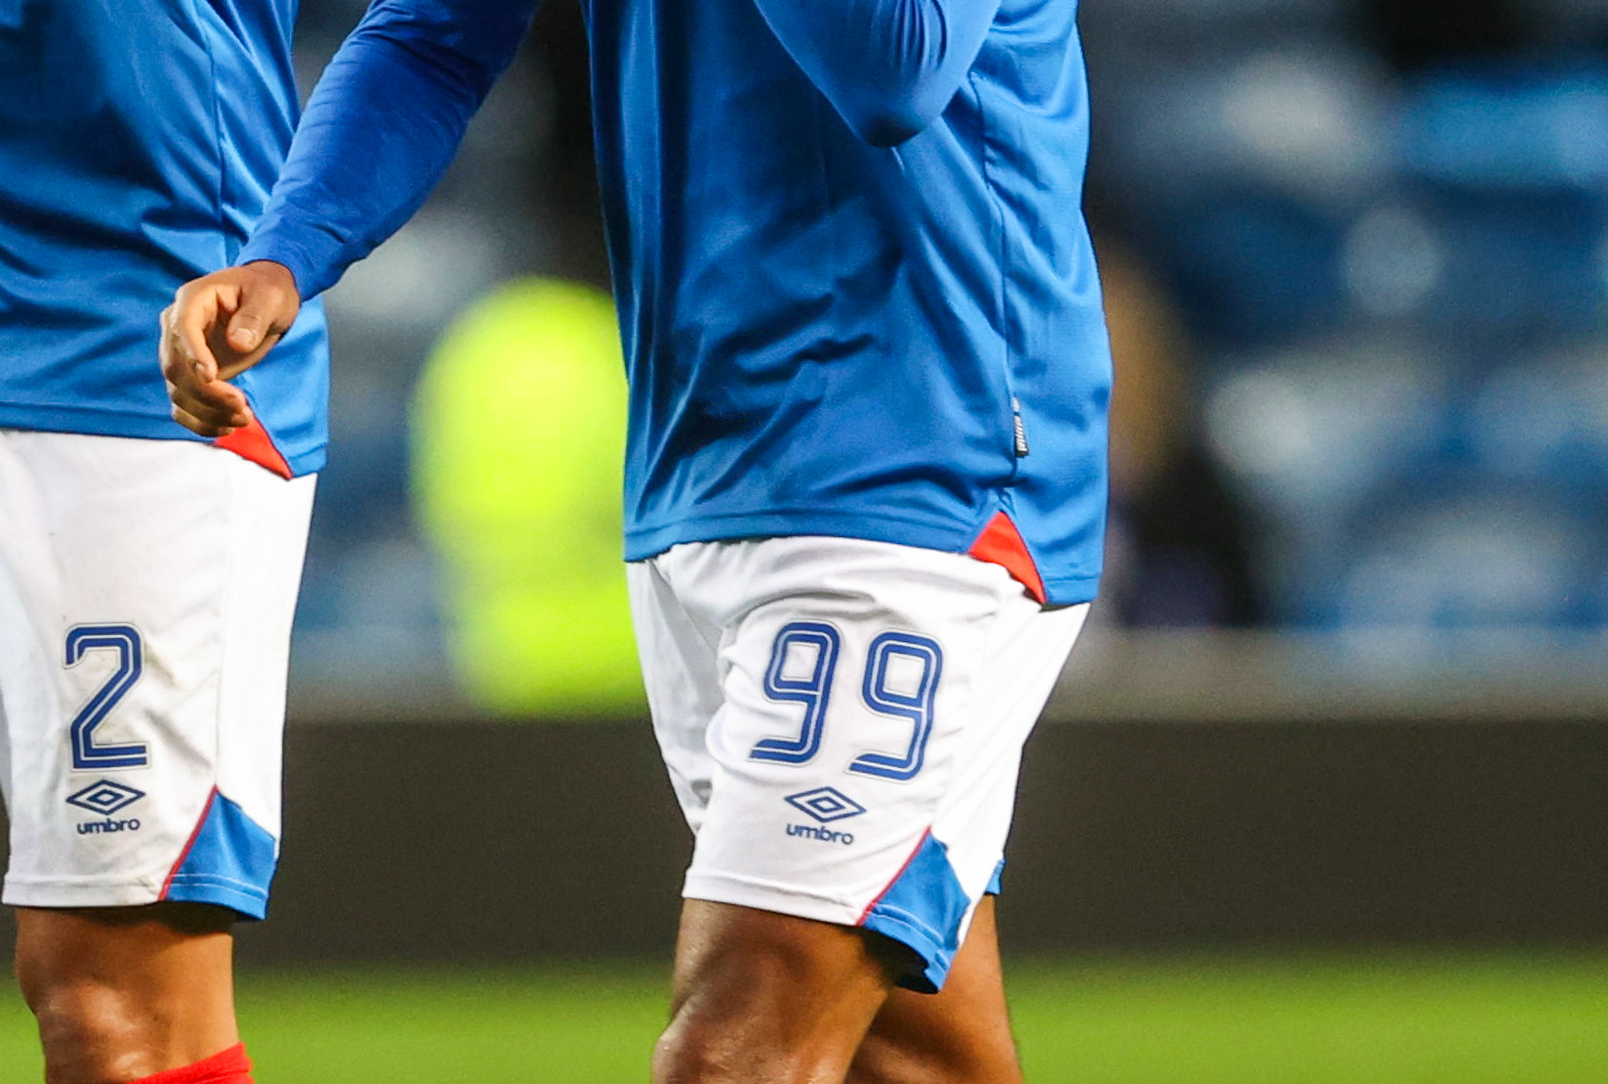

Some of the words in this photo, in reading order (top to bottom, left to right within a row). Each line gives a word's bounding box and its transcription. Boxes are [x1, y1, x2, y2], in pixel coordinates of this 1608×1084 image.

[64, 623, 150, 771] 2
[747, 620, 943, 784] 99
[77, 817, 140, 834] umbro
[786, 822, 854, 845] umbro
